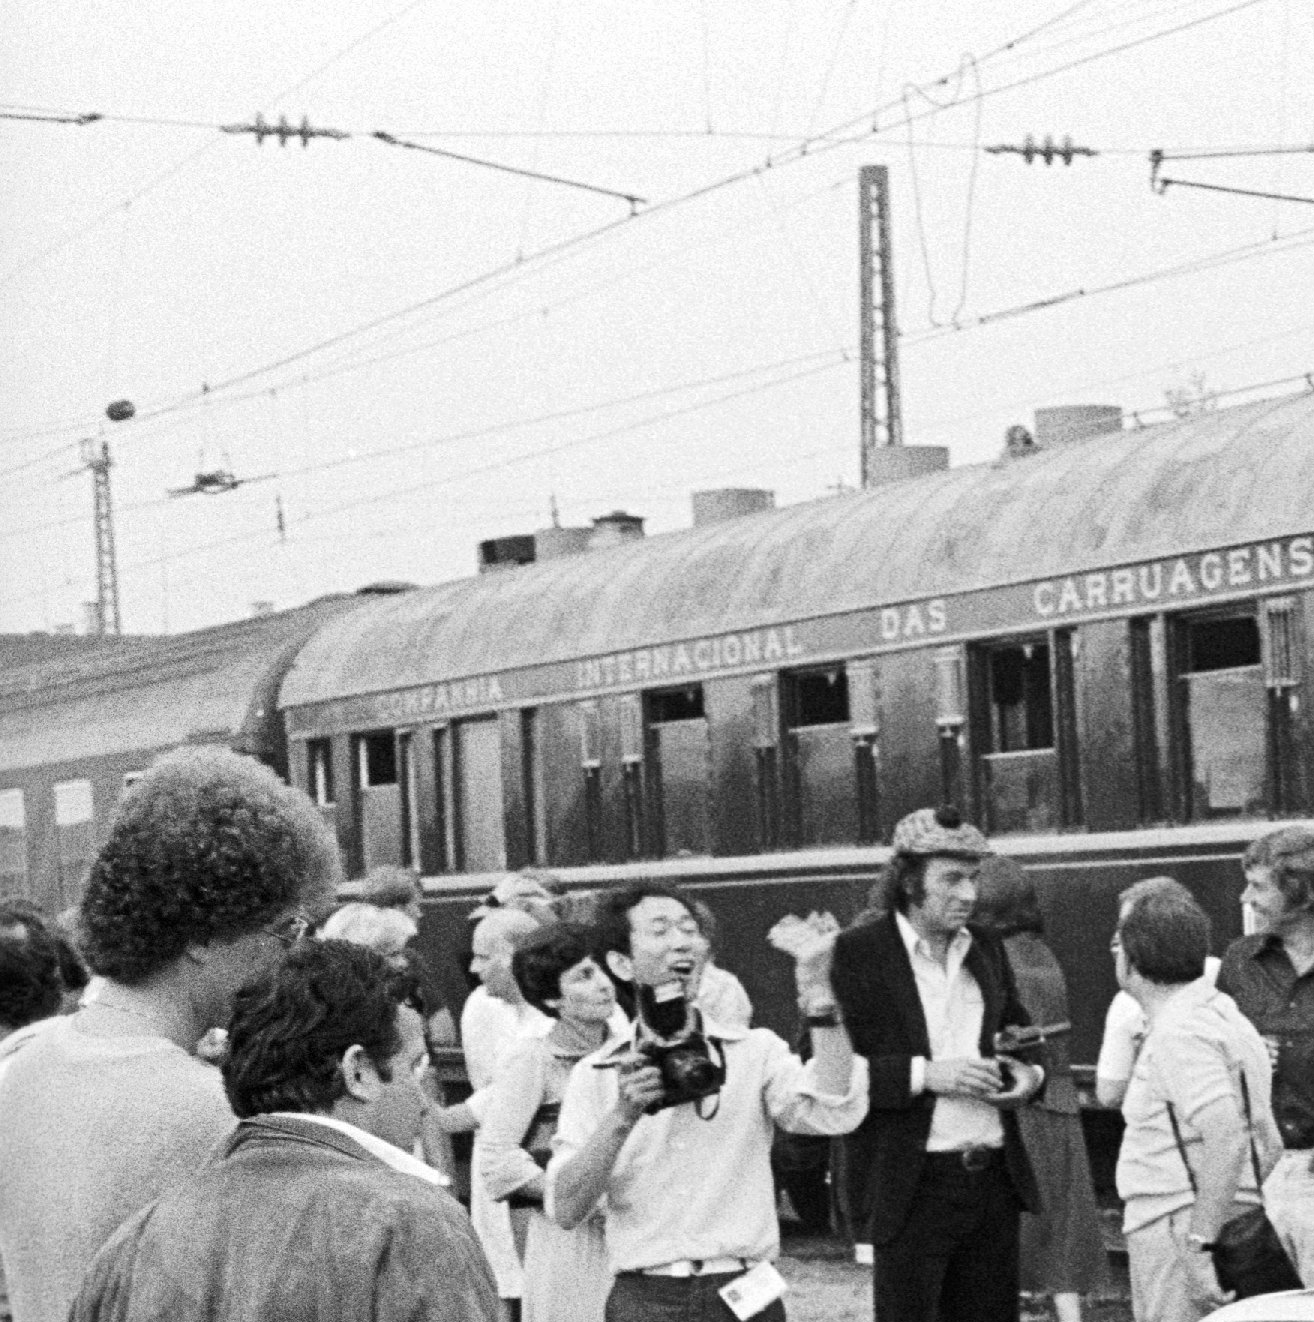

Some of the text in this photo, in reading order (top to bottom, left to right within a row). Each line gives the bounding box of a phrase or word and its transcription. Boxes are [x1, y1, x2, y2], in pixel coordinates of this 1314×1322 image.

[577, 627, 801, 687] INTERNACIONAL
[881, 599, 946, 640] DAS
[1034, 537, 1314, 616] CARRUAGENS
